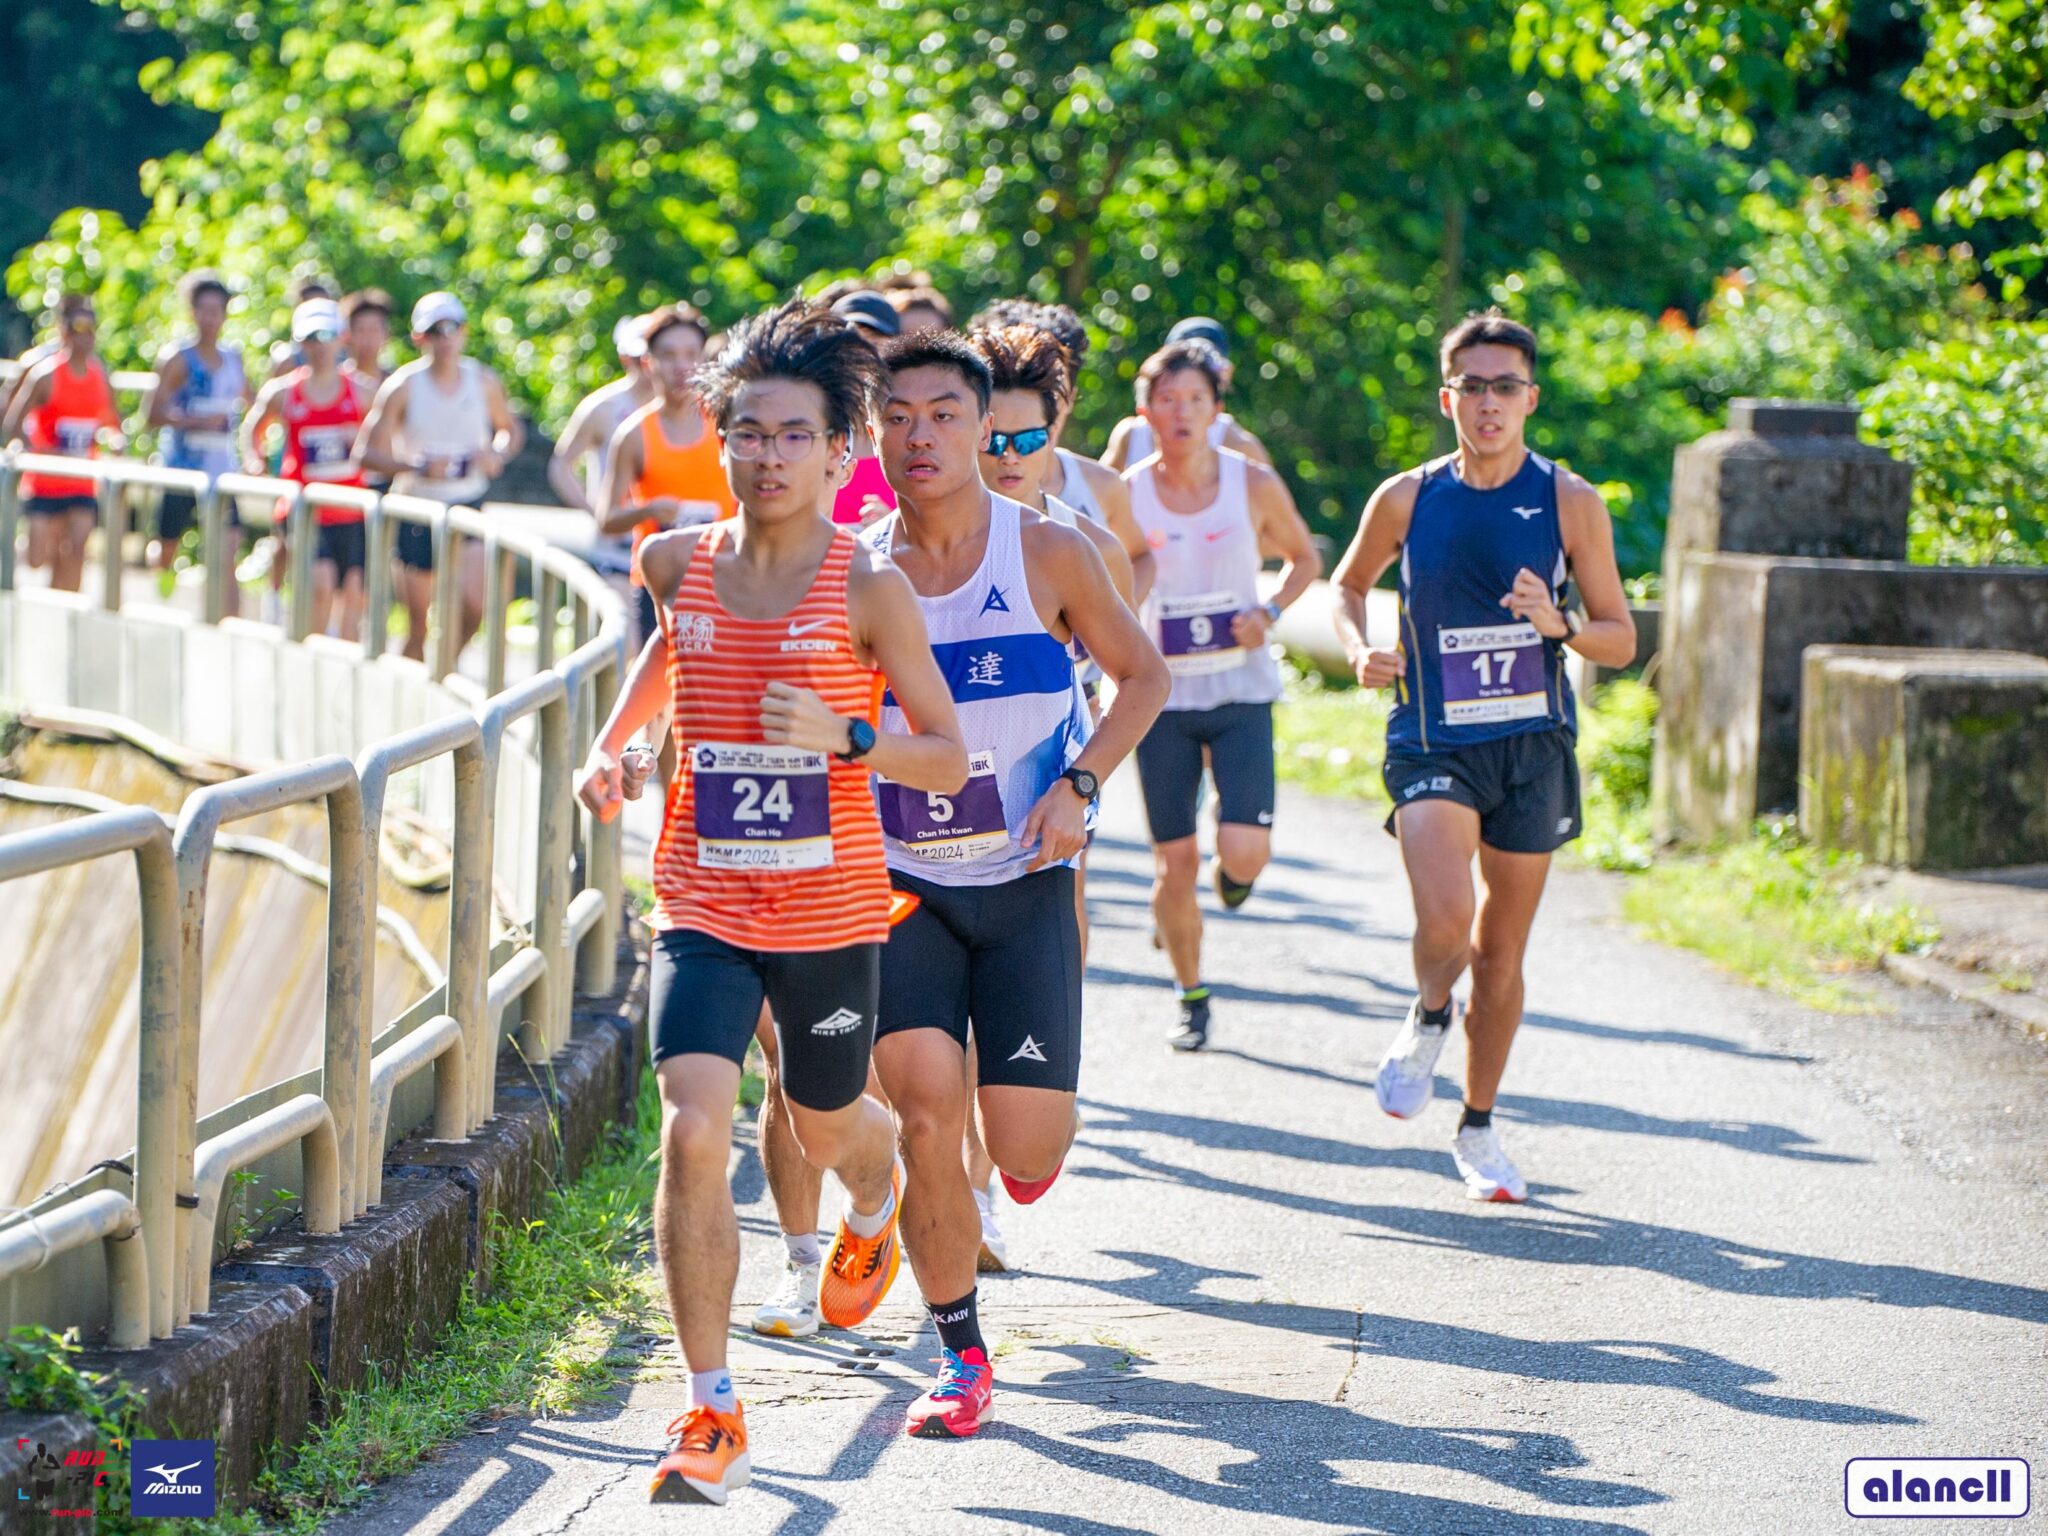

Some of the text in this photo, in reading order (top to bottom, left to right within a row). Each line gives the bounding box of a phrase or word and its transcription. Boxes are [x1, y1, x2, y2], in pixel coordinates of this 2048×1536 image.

[1189, 615, 1213, 646] 9
[780, 640, 837, 652] EKIDEN
[967, 651, 1004, 686] 達
[1471, 650, 1517, 686] 17
[732, 777, 794, 822] 24
[927, 790, 954, 823] 5
[745, 827, 767, 837] Chan
[917, 825, 973, 839] Chan Ho Kwan
[743, 847, 780, 866] 2024
[930, 844, 964, 860] 2024
[811, 1027, 836, 1036] NIKE
[947, 1308, 969, 1324] AKIV
